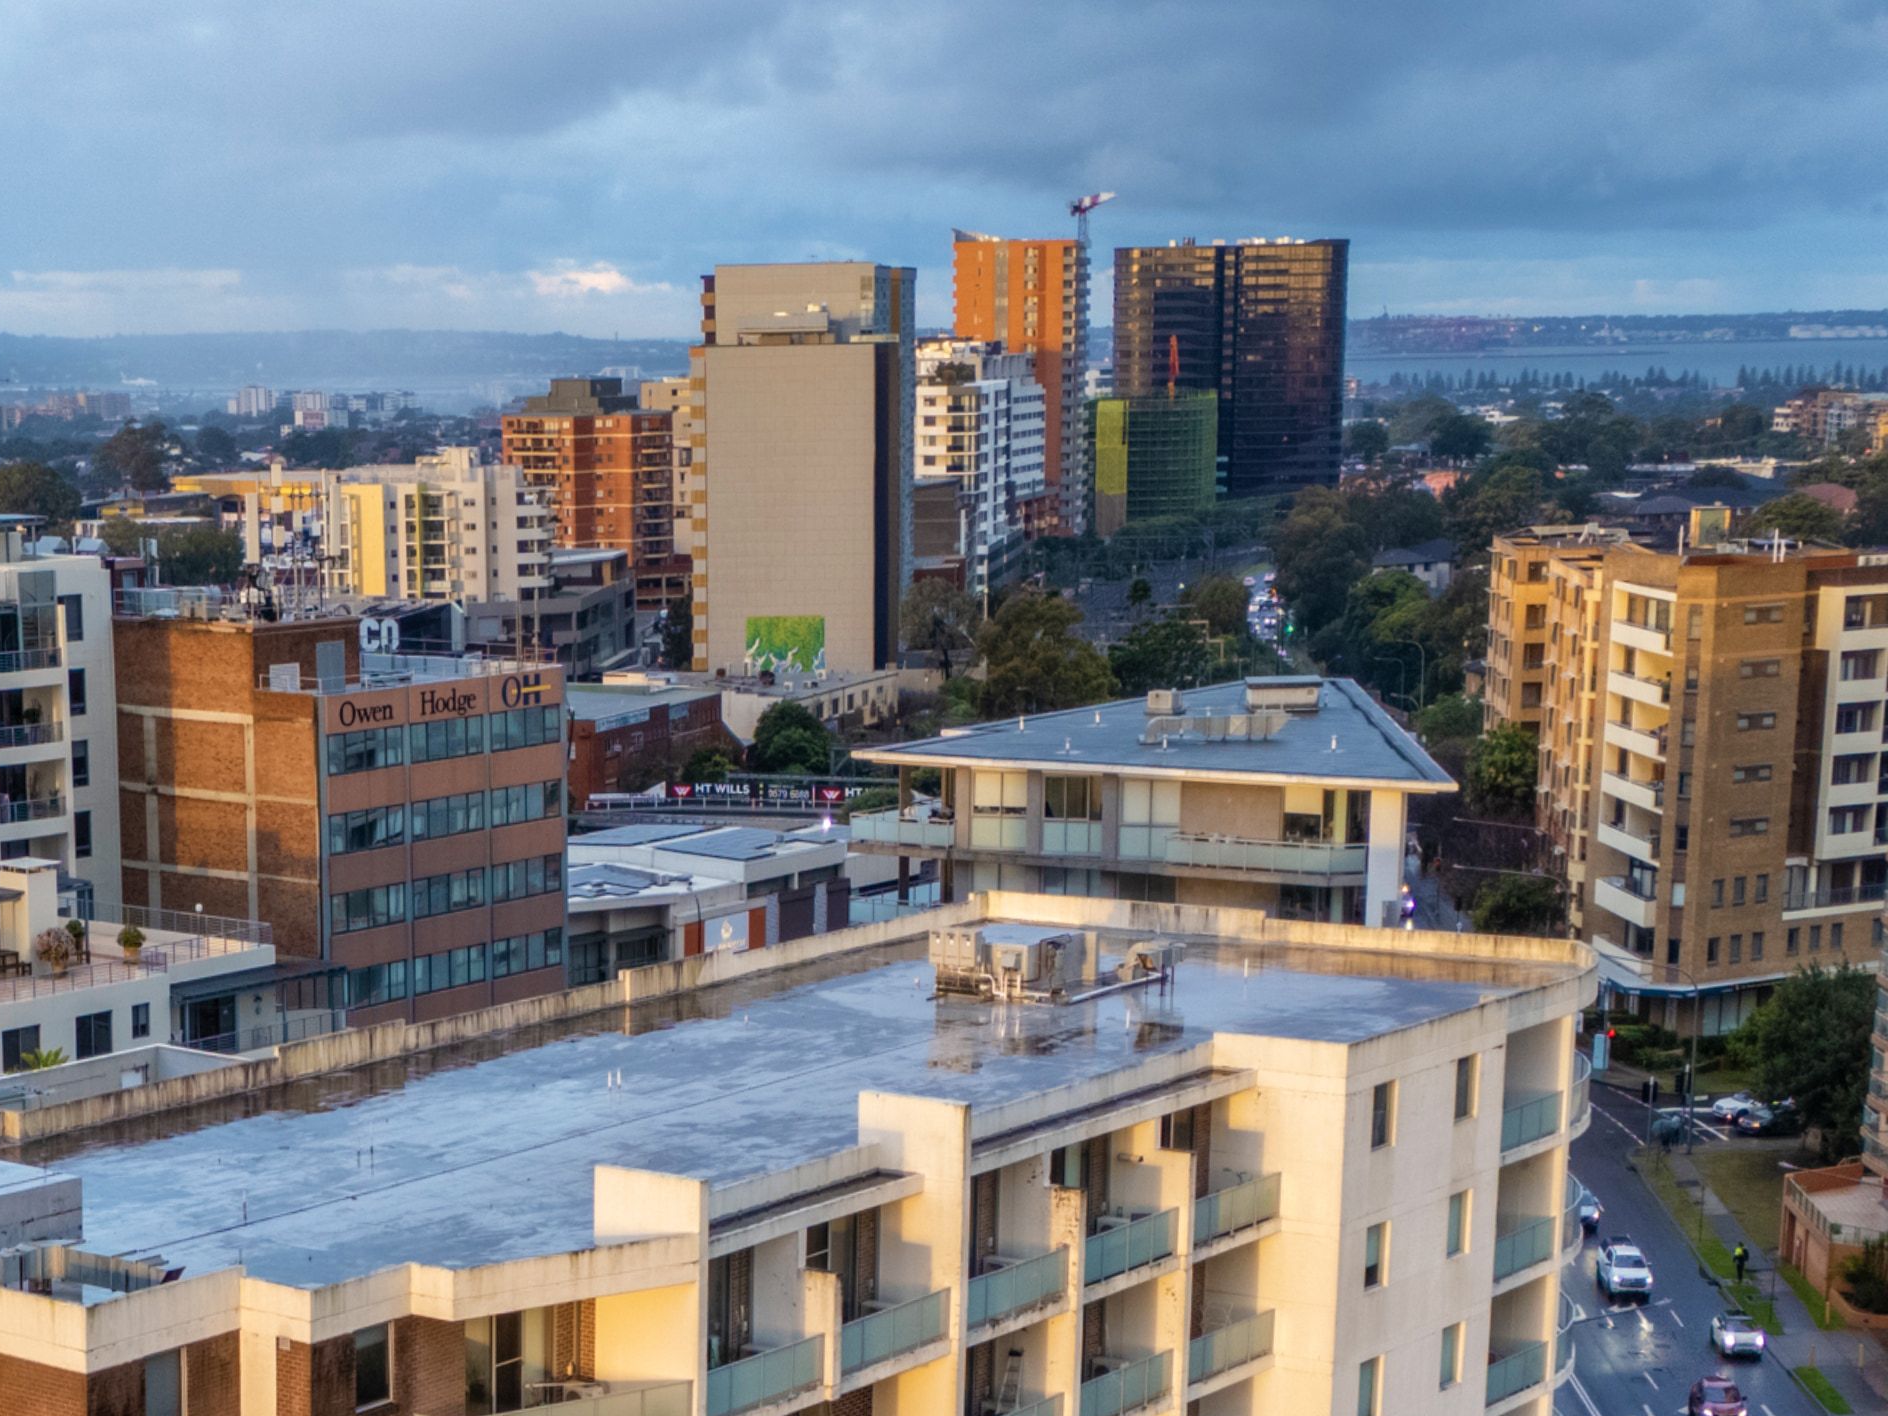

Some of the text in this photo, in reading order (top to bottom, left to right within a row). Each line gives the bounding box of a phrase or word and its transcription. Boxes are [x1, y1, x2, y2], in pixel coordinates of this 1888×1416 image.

[339, 700, 394, 726] Owen
[420, 689, 477, 716] Hodge
[695, 783, 751, 795] HT WILLS
